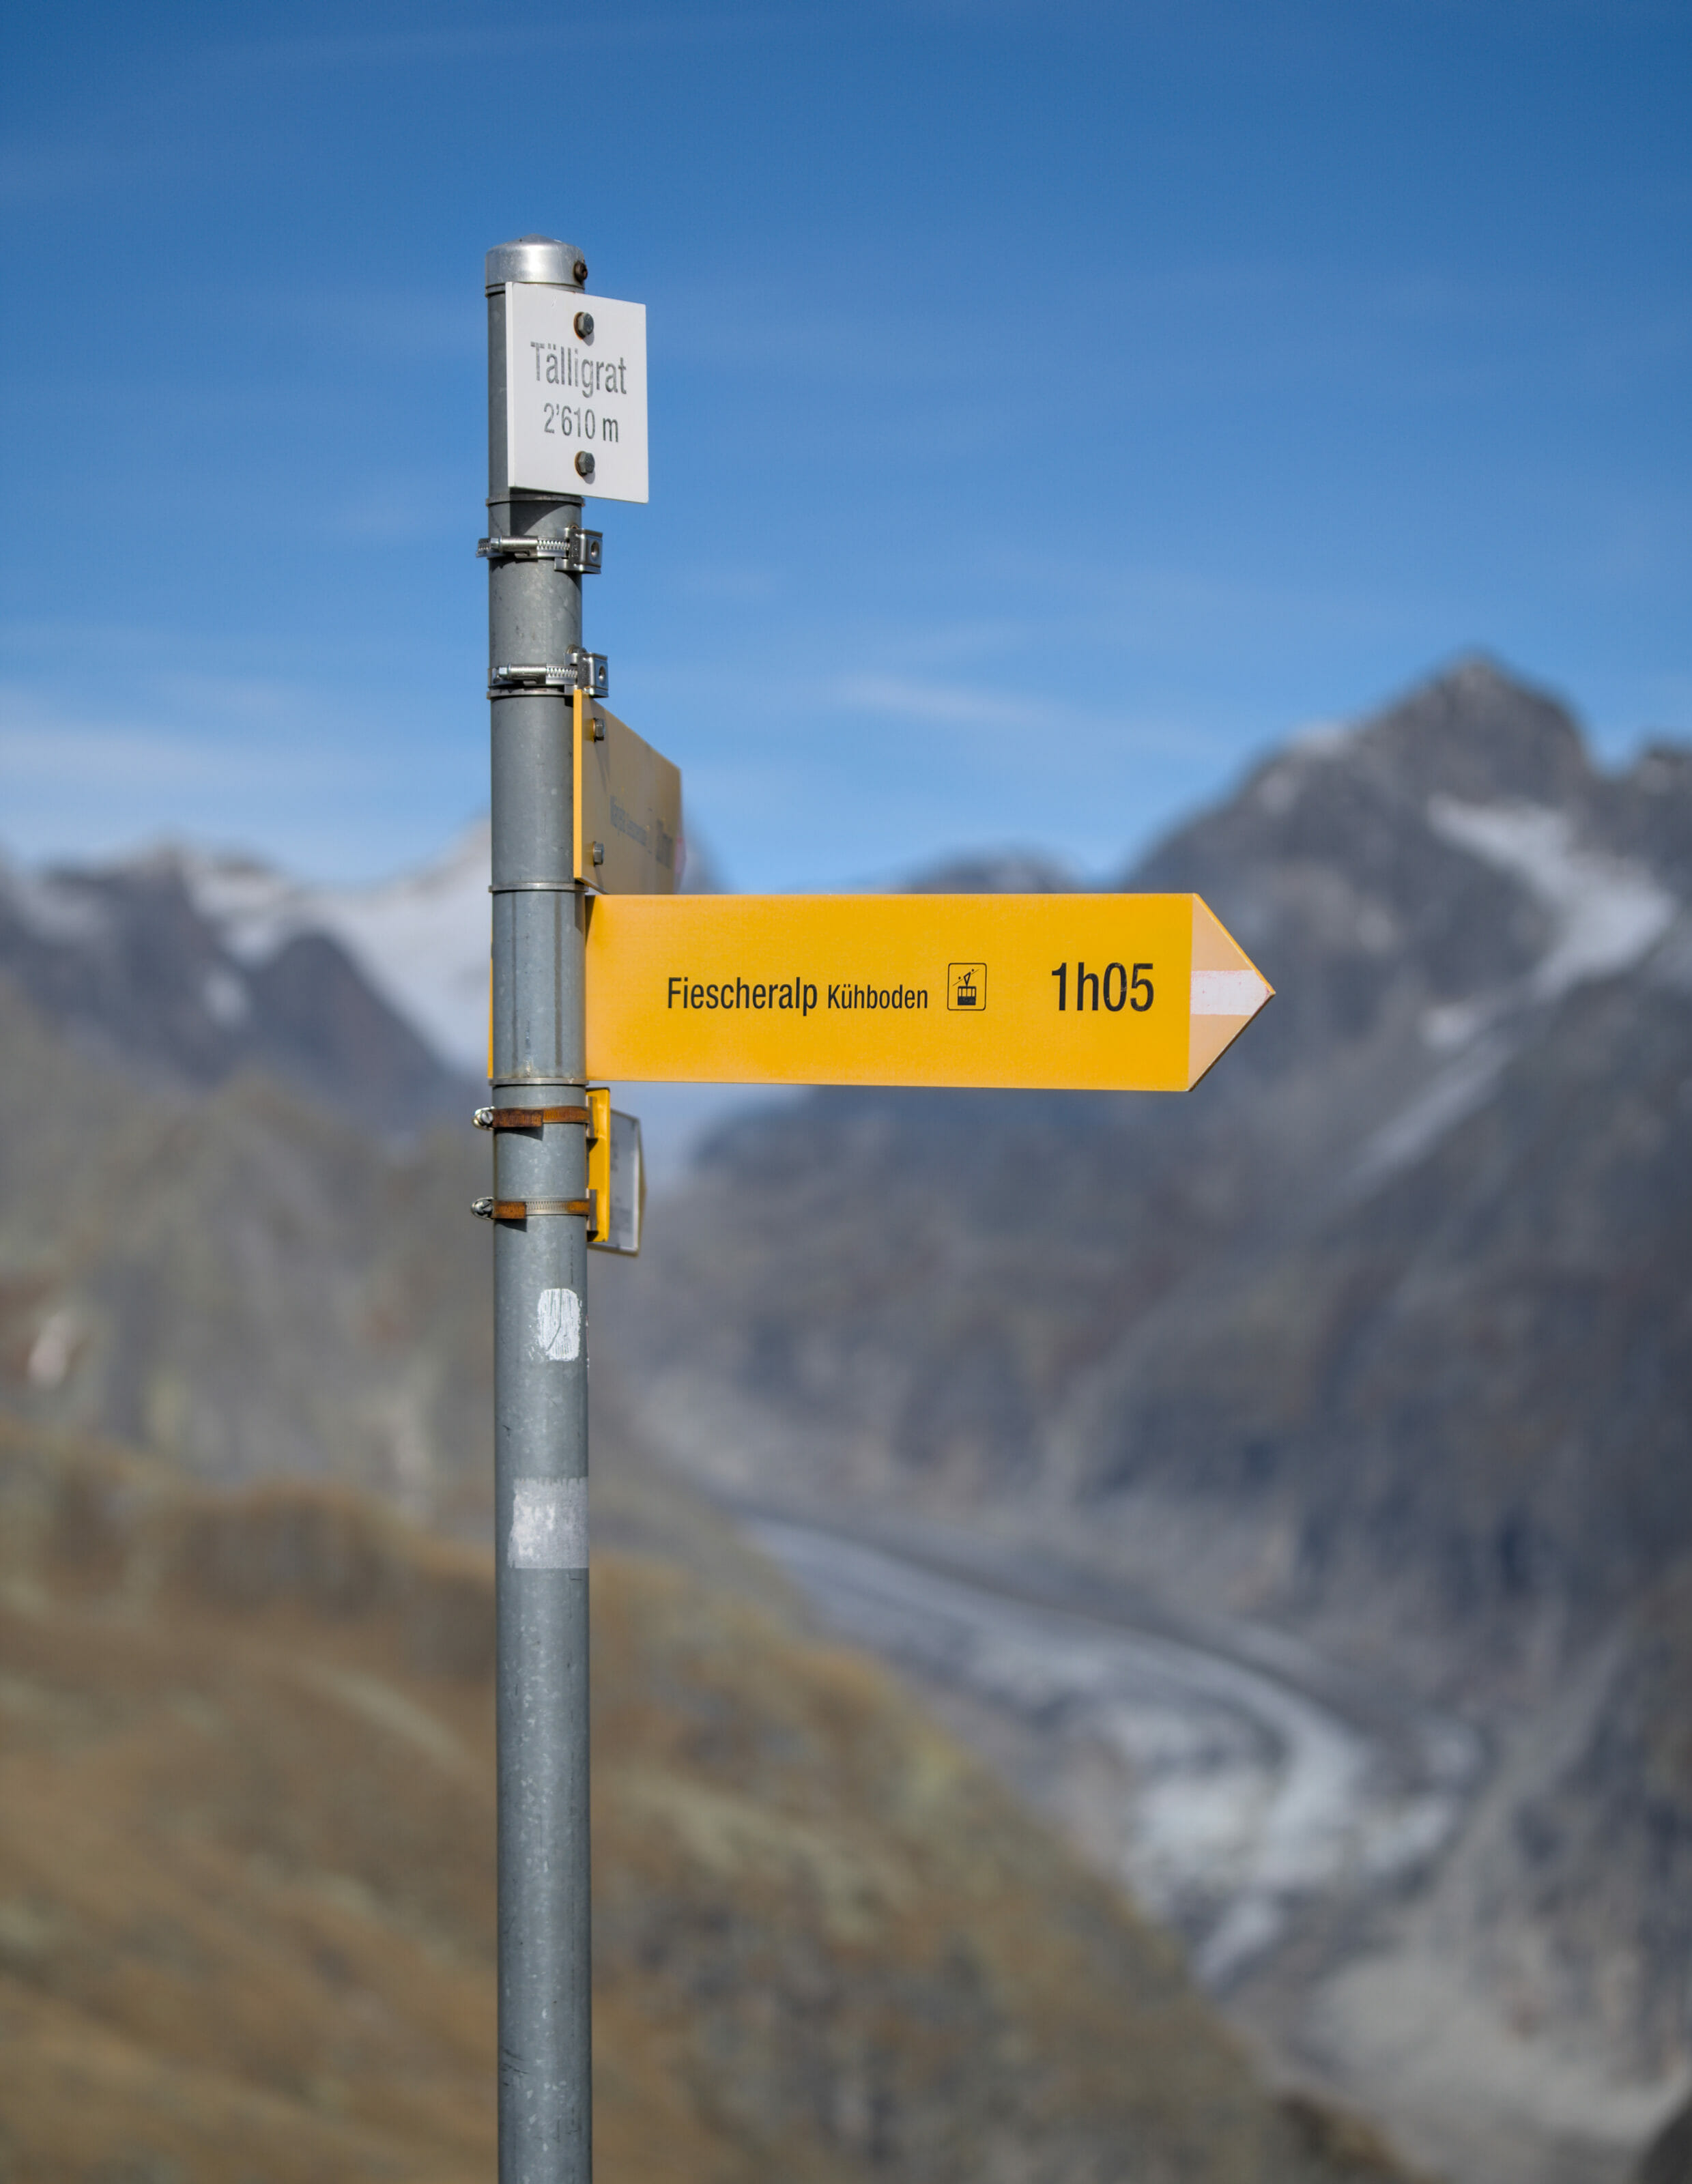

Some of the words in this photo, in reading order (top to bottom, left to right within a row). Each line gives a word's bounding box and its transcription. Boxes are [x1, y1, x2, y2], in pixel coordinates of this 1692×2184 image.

[530, 341, 627, 399] Tälligrat
[543, 403, 596, 440] 2'610
[602, 418, 619, 443] m
[668, 976, 818, 1017] Fiescheralp
[827, 983, 928, 1009] Kühboden
[1051, 961, 1154, 1012] 1h05
